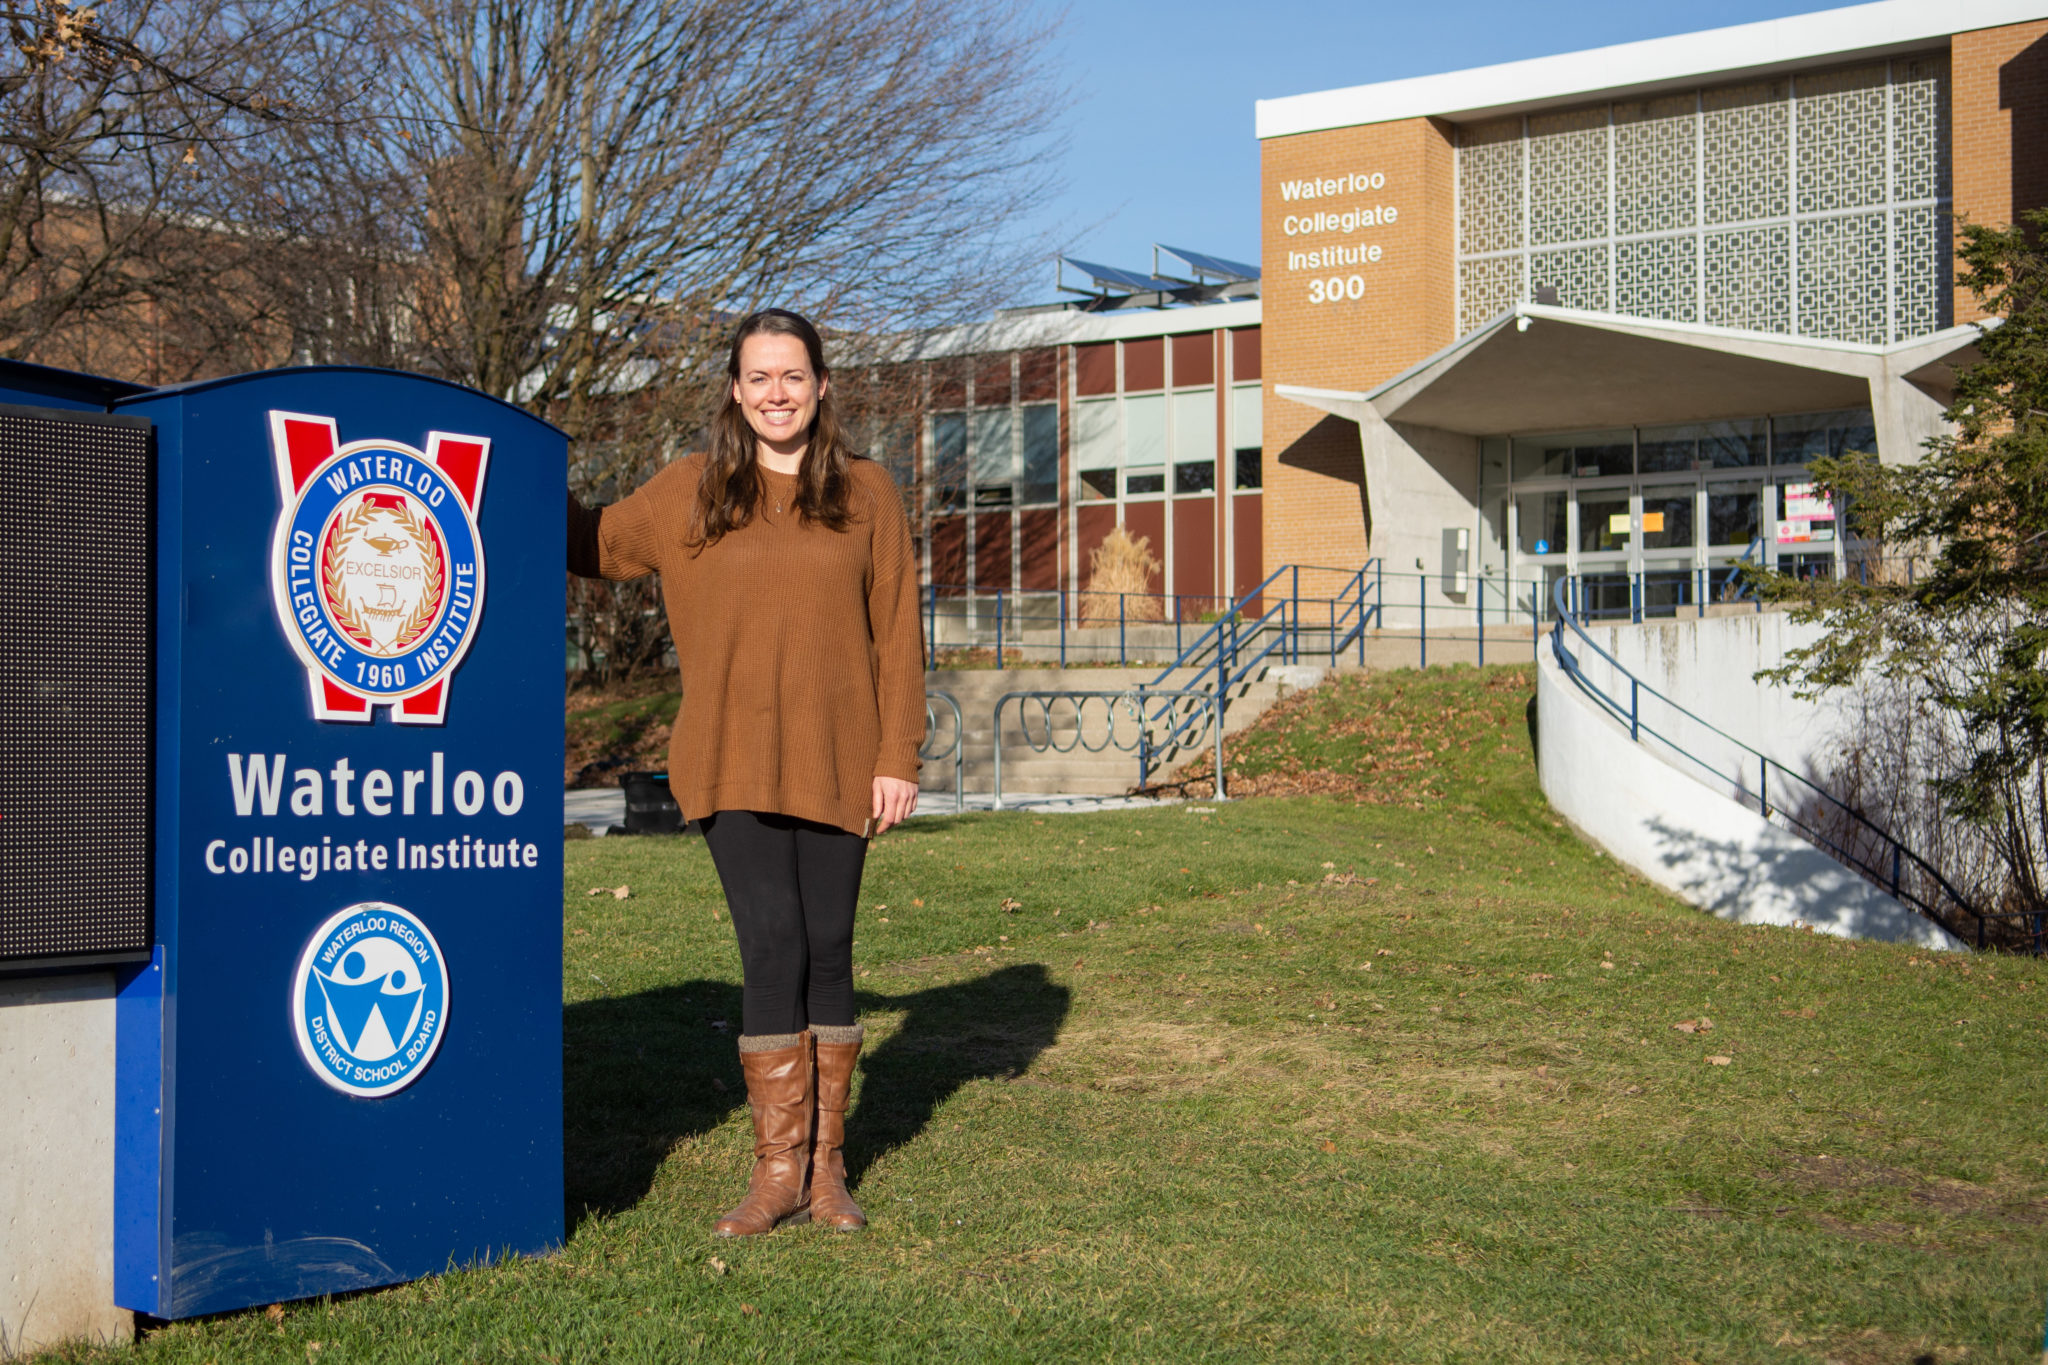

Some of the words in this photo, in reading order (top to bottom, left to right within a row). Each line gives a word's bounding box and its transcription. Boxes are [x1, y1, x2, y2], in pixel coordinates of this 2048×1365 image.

[1281, 172, 1385, 201] Waterloo
[1284, 205, 1398, 236] Collegiate
[1288, 243, 1382, 271] Institute
[1308, 274, 1365, 304] 300
[326, 456, 446, 508] WATERLOO
[346, 561, 421, 580] EXCELSIOR
[291, 530, 346, 669] COLLEGIATE
[356, 661, 406, 688] 1960
[416, 562, 474, 676] INSTITUTE
[228, 752, 524, 816] Waterloo
[205, 836, 388, 881] Collegiate
[398, 835, 538, 869] Institute
[321, 917, 387, 964] WATERLOO
[389, 920, 431, 964] REGION
[311, 1016, 353, 1075] DISTRICT
[354, 1061, 407, 1081] SCHOOL
[406, 1009, 436, 1063] BOARD
